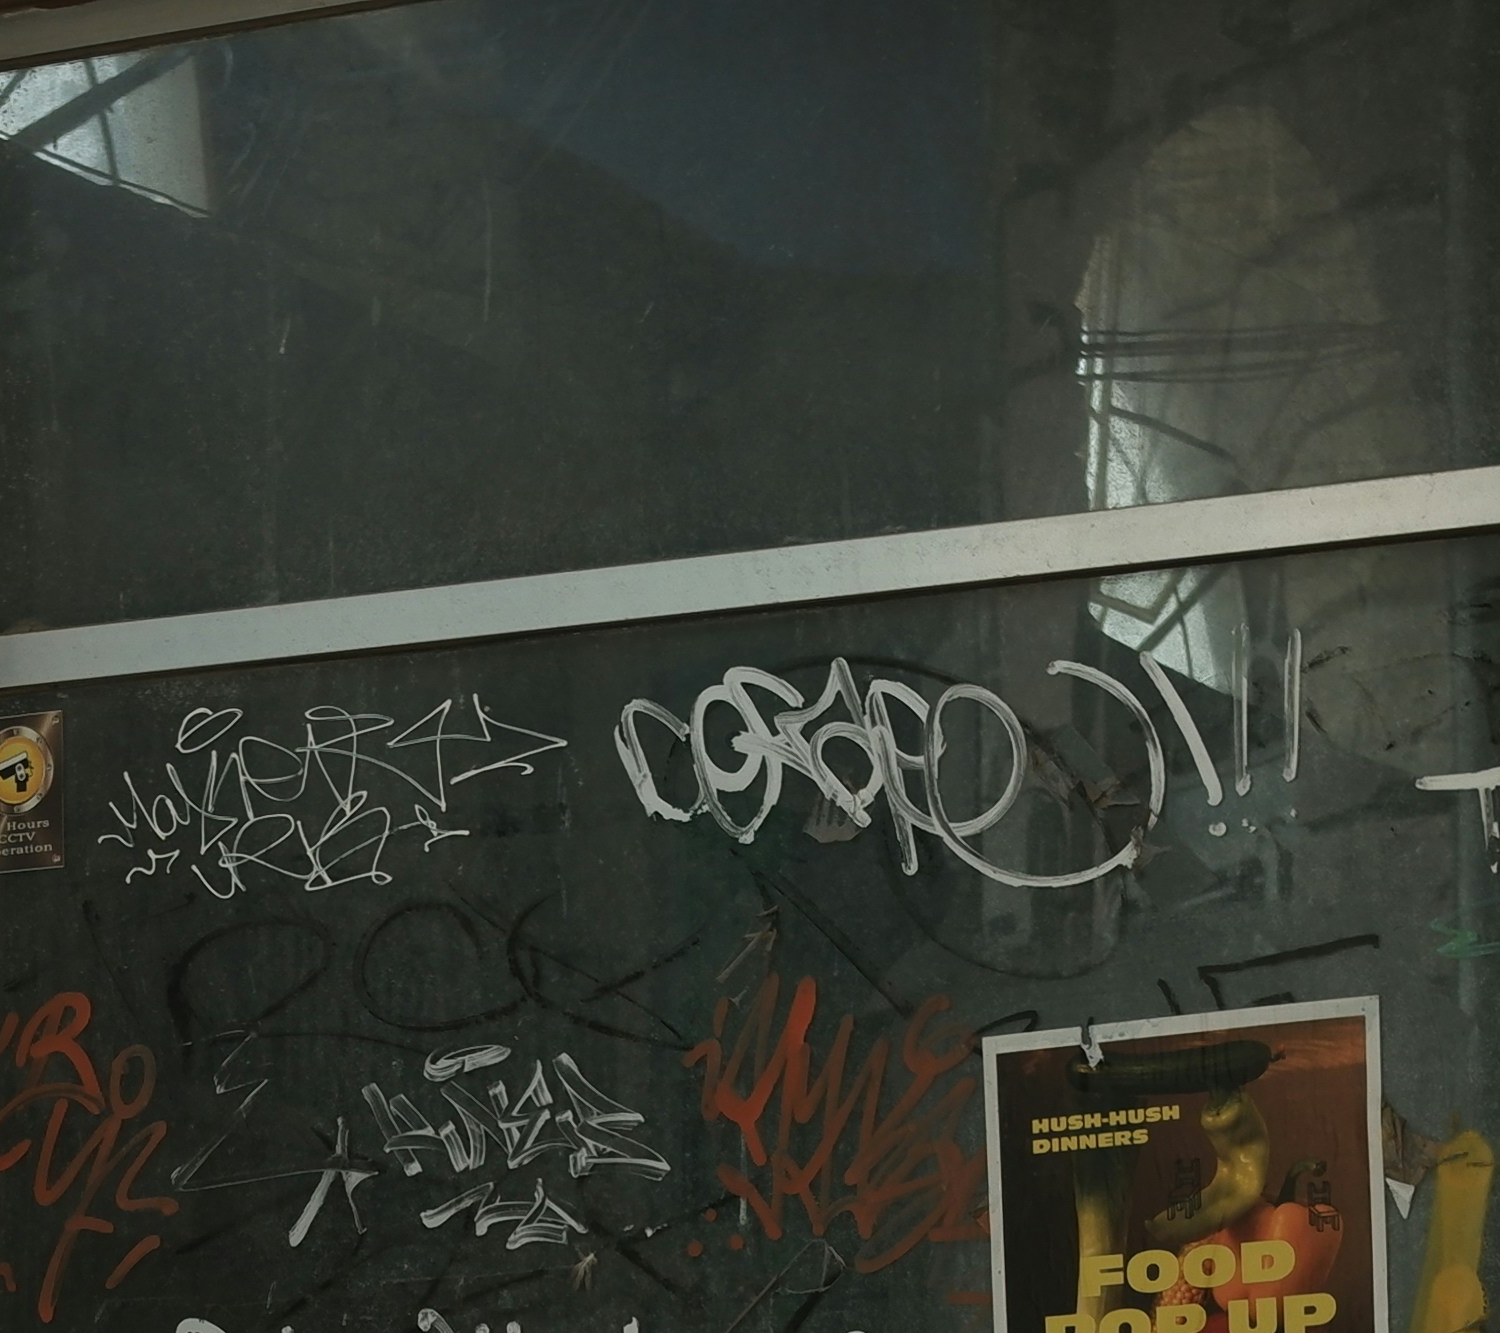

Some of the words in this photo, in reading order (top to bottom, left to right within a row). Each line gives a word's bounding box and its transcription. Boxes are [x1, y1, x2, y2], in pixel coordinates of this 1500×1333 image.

[7, 820, 50, 831] Hours
[1032, 1105, 1180, 1134] HUSH-HUSH
[1032, 1128, 1149, 1154] DINNERS
[1080, 1239, 1297, 1297] FOOD
